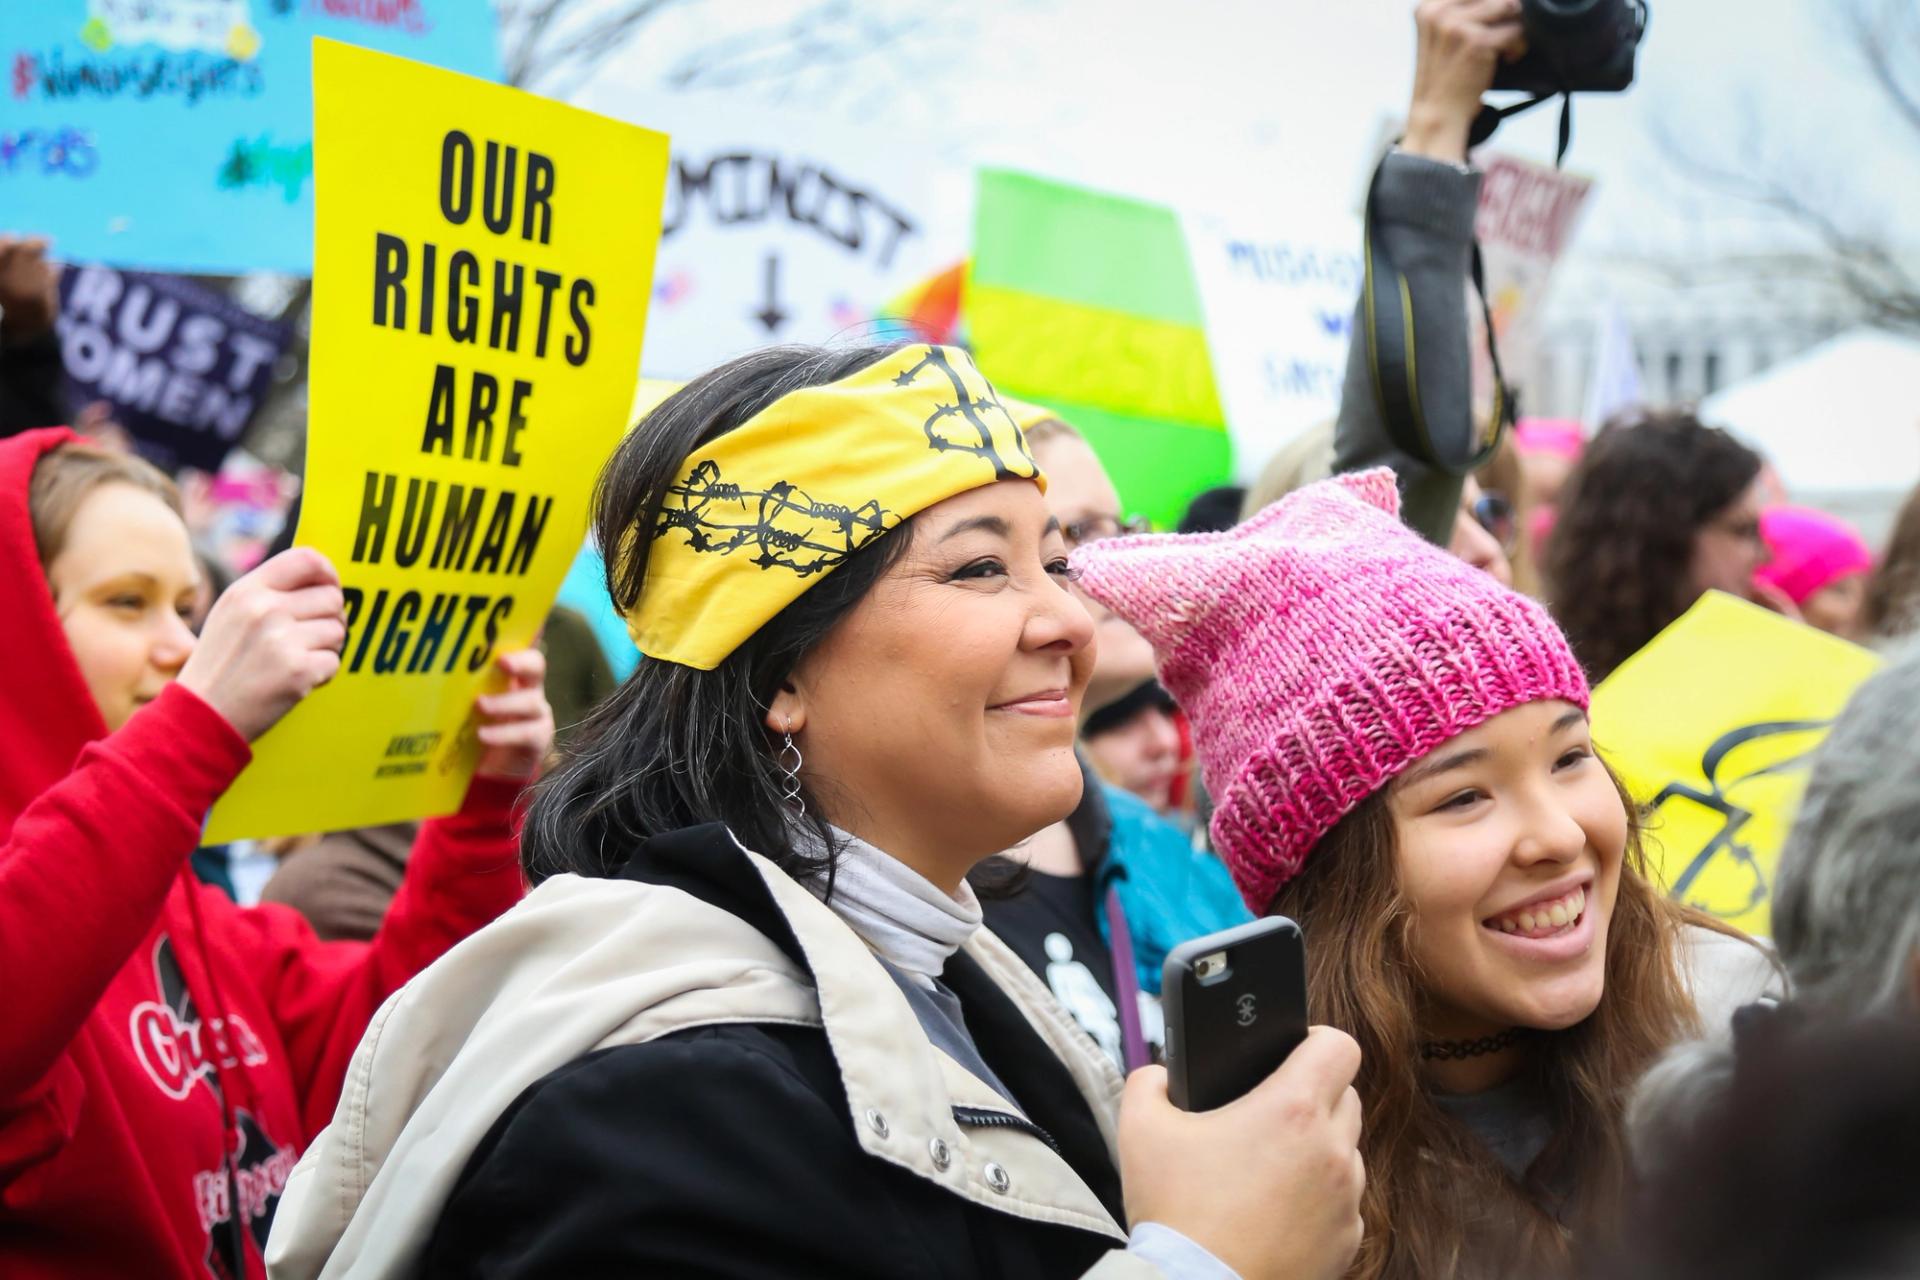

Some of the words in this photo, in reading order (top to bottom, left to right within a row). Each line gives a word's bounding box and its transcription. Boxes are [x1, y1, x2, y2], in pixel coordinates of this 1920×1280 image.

[440, 130, 555, 245] OUR
[662, 150, 916, 268] MINIST
[70, 264, 276, 392] RUST
[373, 232, 595, 366] RIGHTS
[421, 364, 532, 466] ARE
[351, 471, 553, 576] HUMAN
